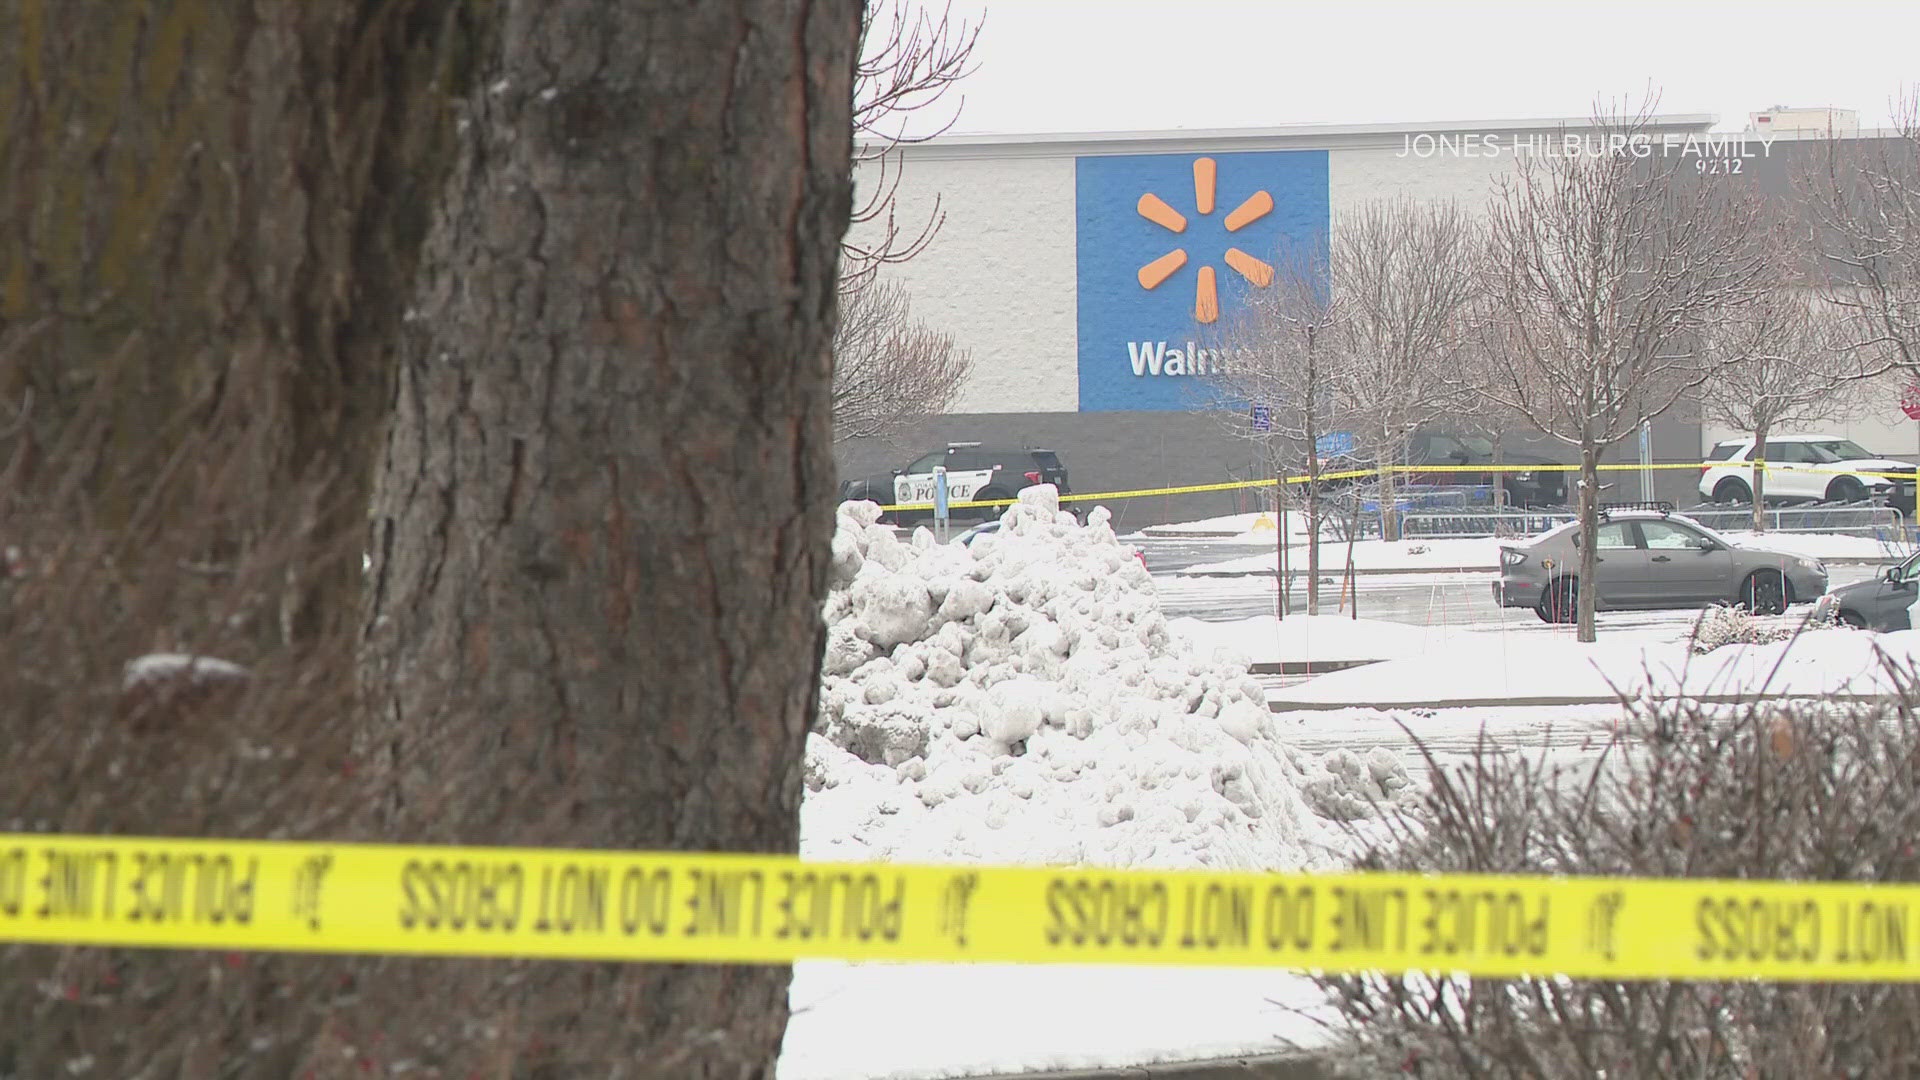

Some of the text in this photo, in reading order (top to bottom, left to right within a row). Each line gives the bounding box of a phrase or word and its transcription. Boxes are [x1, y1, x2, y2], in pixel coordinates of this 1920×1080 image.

[1695, 158, 1743, 175] 9212
[1127, 341, 1248, 376] Walm
[916, 485, 970, 500] POICE
[0, 847, 259, 926] POLICE LINE D
[399, 858, 906, 943] POLICE LINE DO NOT CROSS
[1044, 877, 1551, 957] POLICE LINE DO NOT CROSS
[1694, 895, 1909, 965] NOT CROSS
